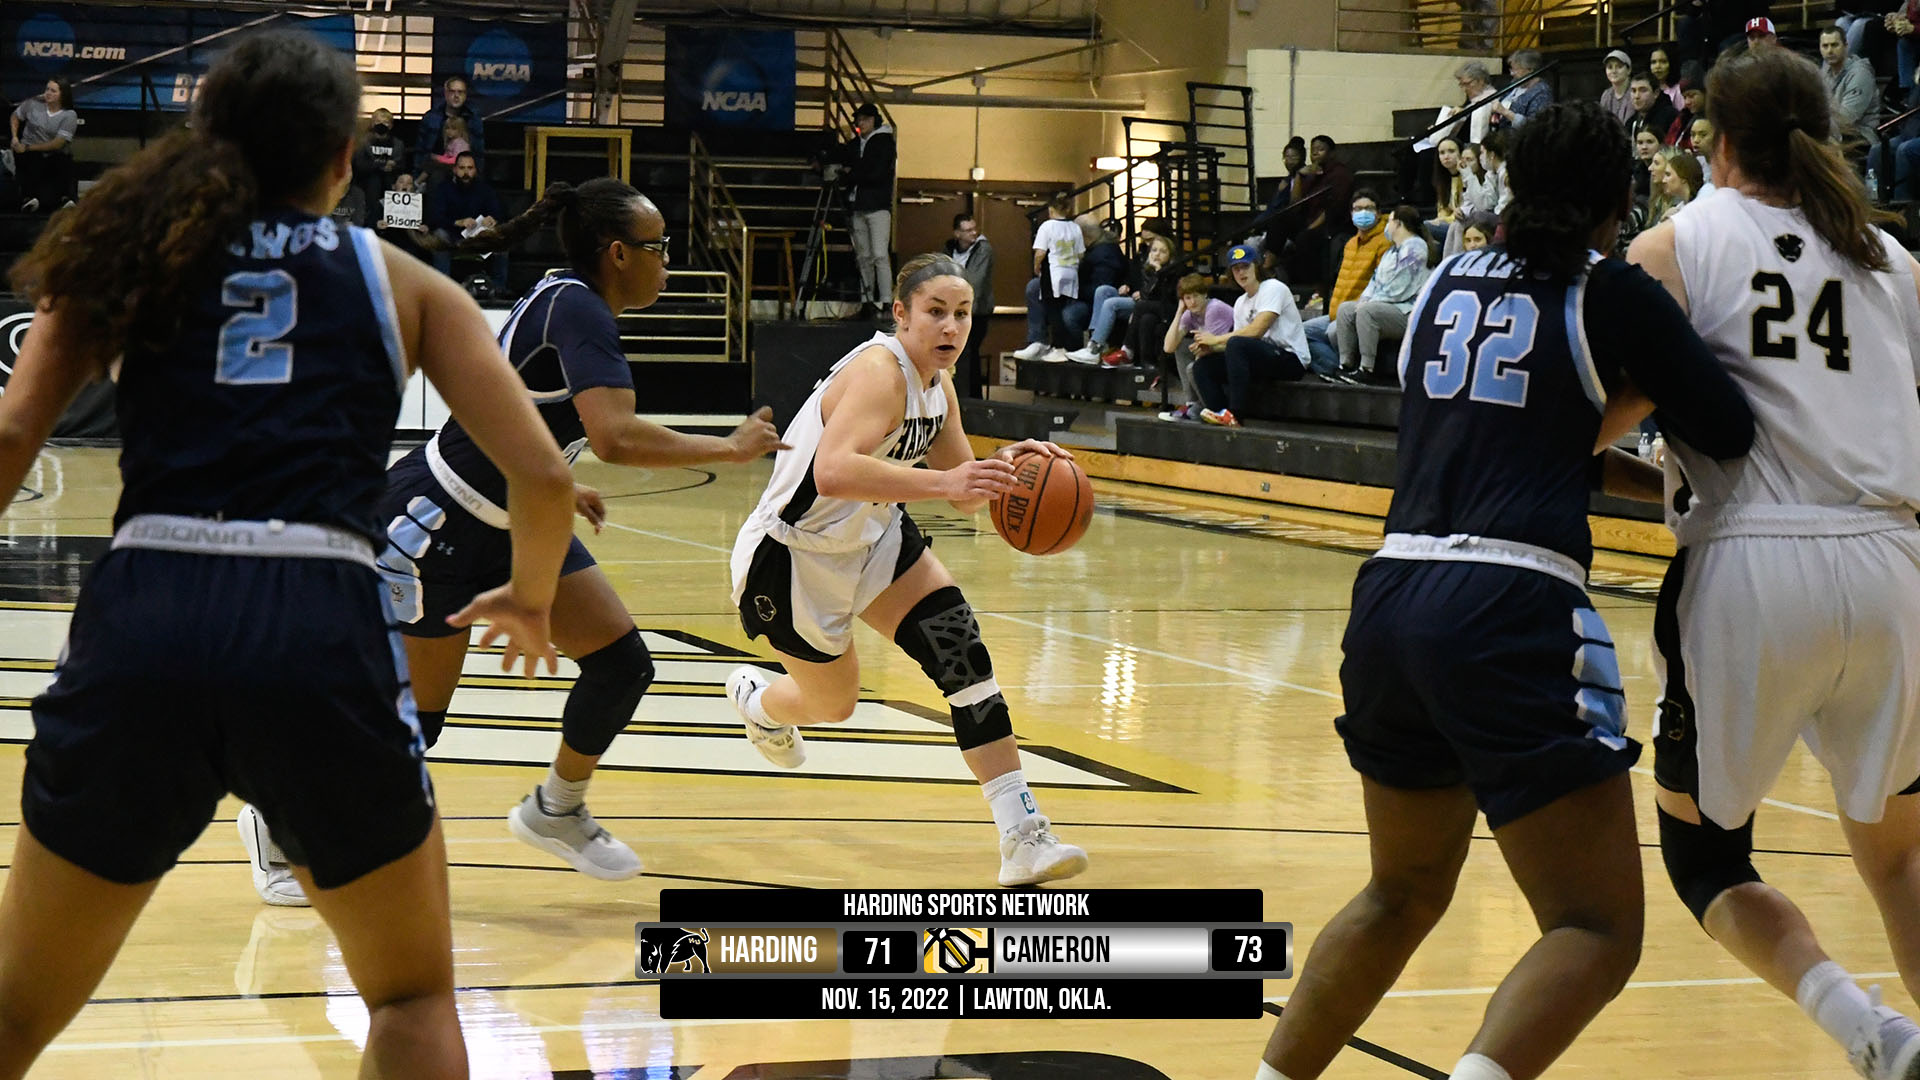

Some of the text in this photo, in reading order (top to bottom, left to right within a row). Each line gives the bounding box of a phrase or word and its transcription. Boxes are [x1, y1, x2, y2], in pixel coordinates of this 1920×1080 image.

[23, 41, 126, 61] NCAA.com
[472, 61, 531, 82] NCAA
[702, 90, 767, 113] NCAA
[391, 192, 412, 206] GO
[386, 214, 422, 228] Bisons
[214, 268, 300, 385] 2
[1750, 269, 1851, 374] 24
[1423, 289, 1541, 408] 32
[1007, 493, 1030, 534] ROCK
